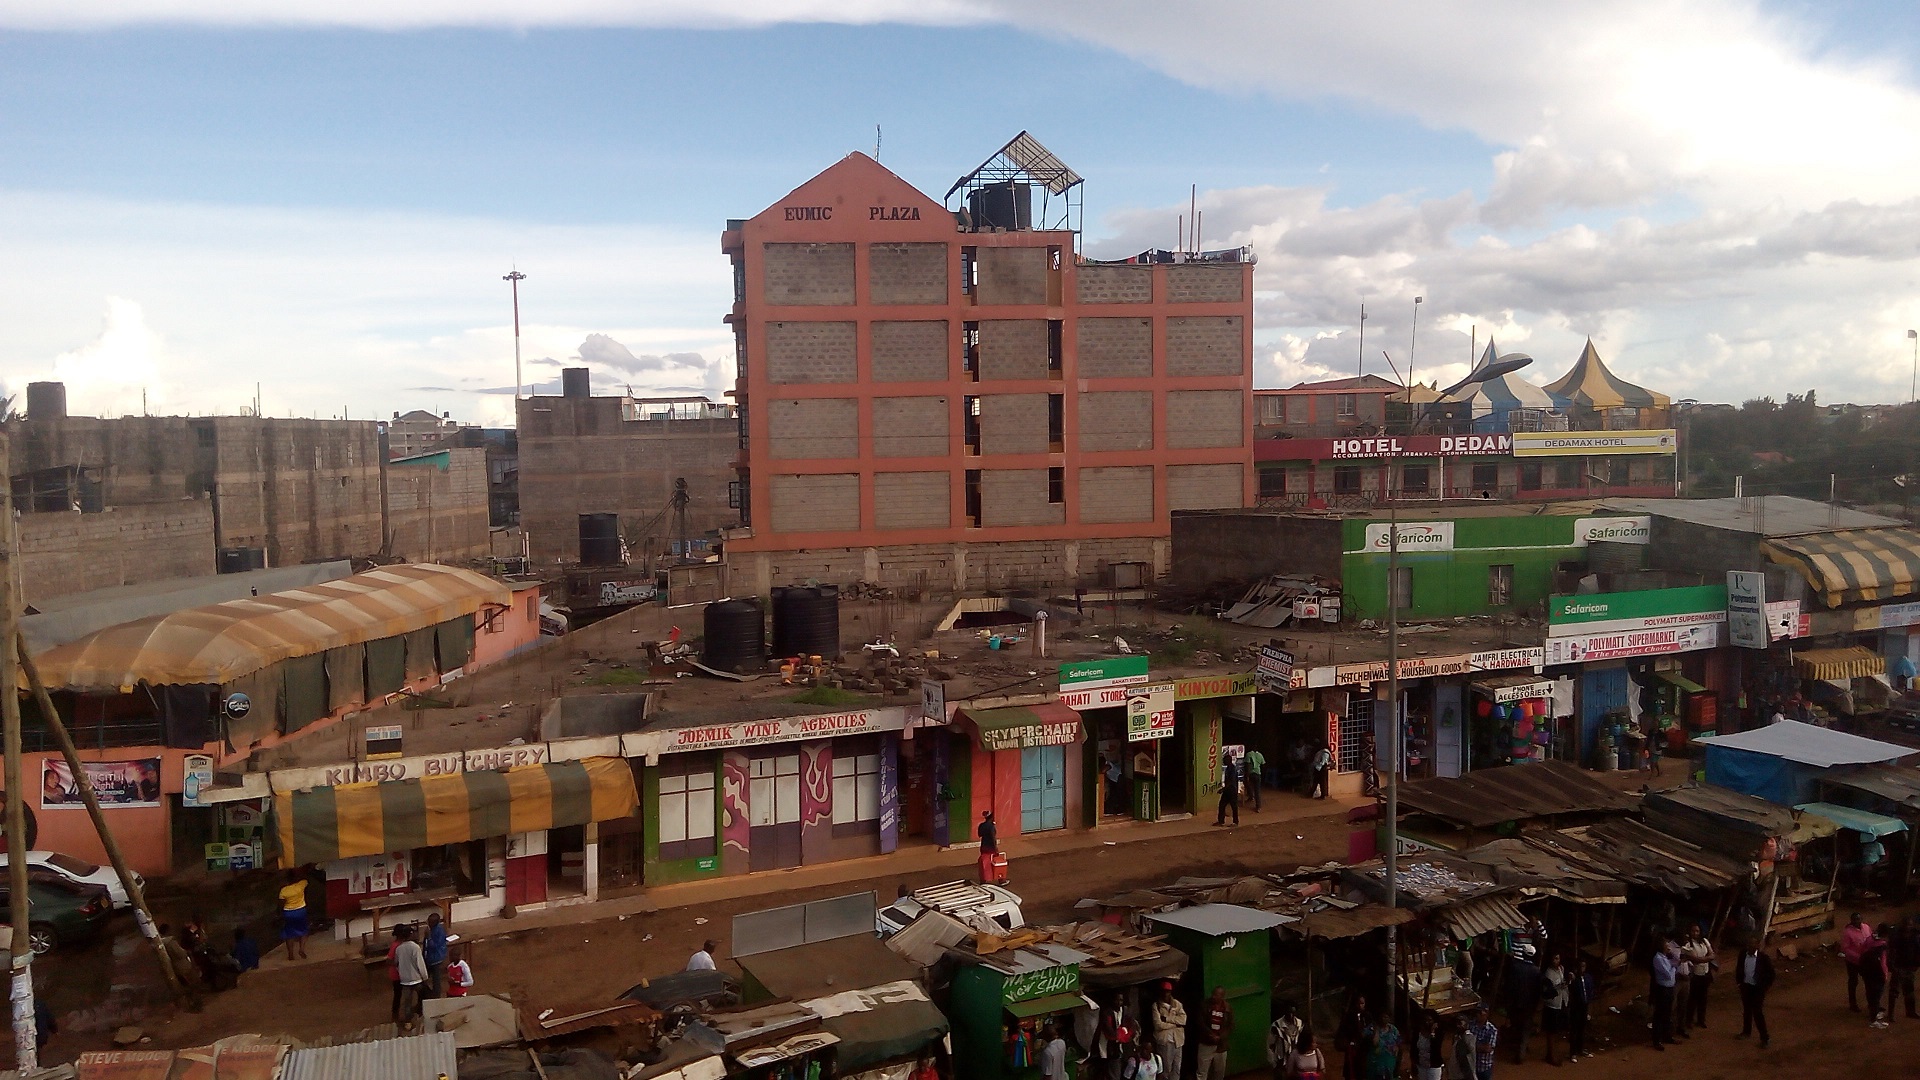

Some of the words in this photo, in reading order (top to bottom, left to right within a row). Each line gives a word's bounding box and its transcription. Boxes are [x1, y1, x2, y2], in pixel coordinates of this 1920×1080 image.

[784, 207, 833, 221] EUMIC
[869, 207, 921, 221] PLAZA
[1333, 439, 1403, 454] HOTEL
[1544, 439, 1593, 448] DEDAMAX
[1594, 438, 1626, 447] HOTEL
[1380, 532, 1443, 546] Sfaricom
[1588, 525, 1648, 539] Safaricom
[1564, 603, 1608, 615] Safaricom
[1644, 616, 1678, 626] POLYMATT
[1678, 612, 1725, 623] SUPERMARKET
[1588, 635, 1625, 651] POLYMATT
[1628, 630, 1676, 647] SUPERMARKET
[1472, 651, 1499, 663] JAMFRI
[1499, 648, 1542, 661] ELECTRICAL
[1612, 648, 1642, 657] Peoples
[1645, 645, 1671, 653] Choice
[1260, 657, 1291, 675] CHEMIST
[1489, 657, 1531, 668] HARDWARE
[1069, 669, 1104, 679] Safaricom
[1341, 670, 1391, 683] KITCHENWAR
[1401, 665, 1438, 678] HOUSEHOLD
[1441, 663, 1462, 674] GOODS
[1178, 679, 1232, 697] KINYOZI
[1498, 689, 1546, 701] ACCESSORIES
[1512, 685, 1535, 693] PHONE
[1100, 689, 1127, 703] STORES
[677, 727, 733, 745] JOEMIK
[743, 722, 781, 738] WINE
[800, 713, 867, 733] AGENCIES
[1023, 733, 1075, 747] DISTRIBUTORS
[325, 763, 406, 786] KIMBO
[424, 748, 546, 776] BUTCHERY
[1034, 972, 1077, 995] SHOP
[79, 1052, 121, 1065] STEVE
